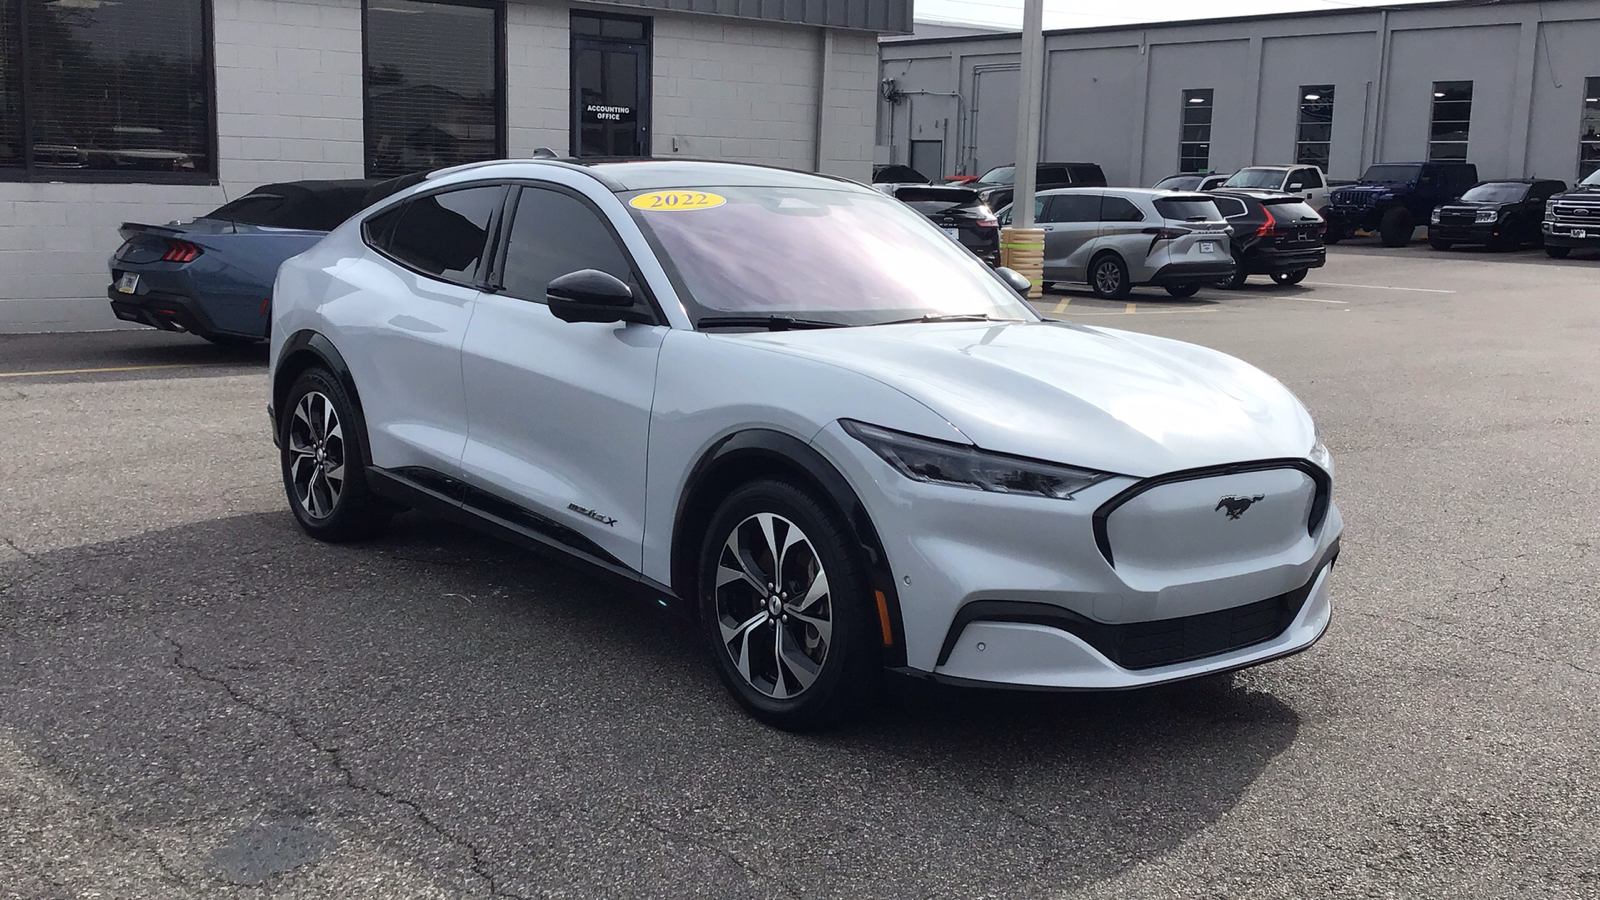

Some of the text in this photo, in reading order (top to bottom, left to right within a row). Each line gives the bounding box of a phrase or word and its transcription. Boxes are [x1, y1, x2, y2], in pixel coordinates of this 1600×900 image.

[587, 104, 630, 114] ACCOUNTING
[597, 112, 621, 121] OFFICE
[650, 193, 709, 208] 2022
